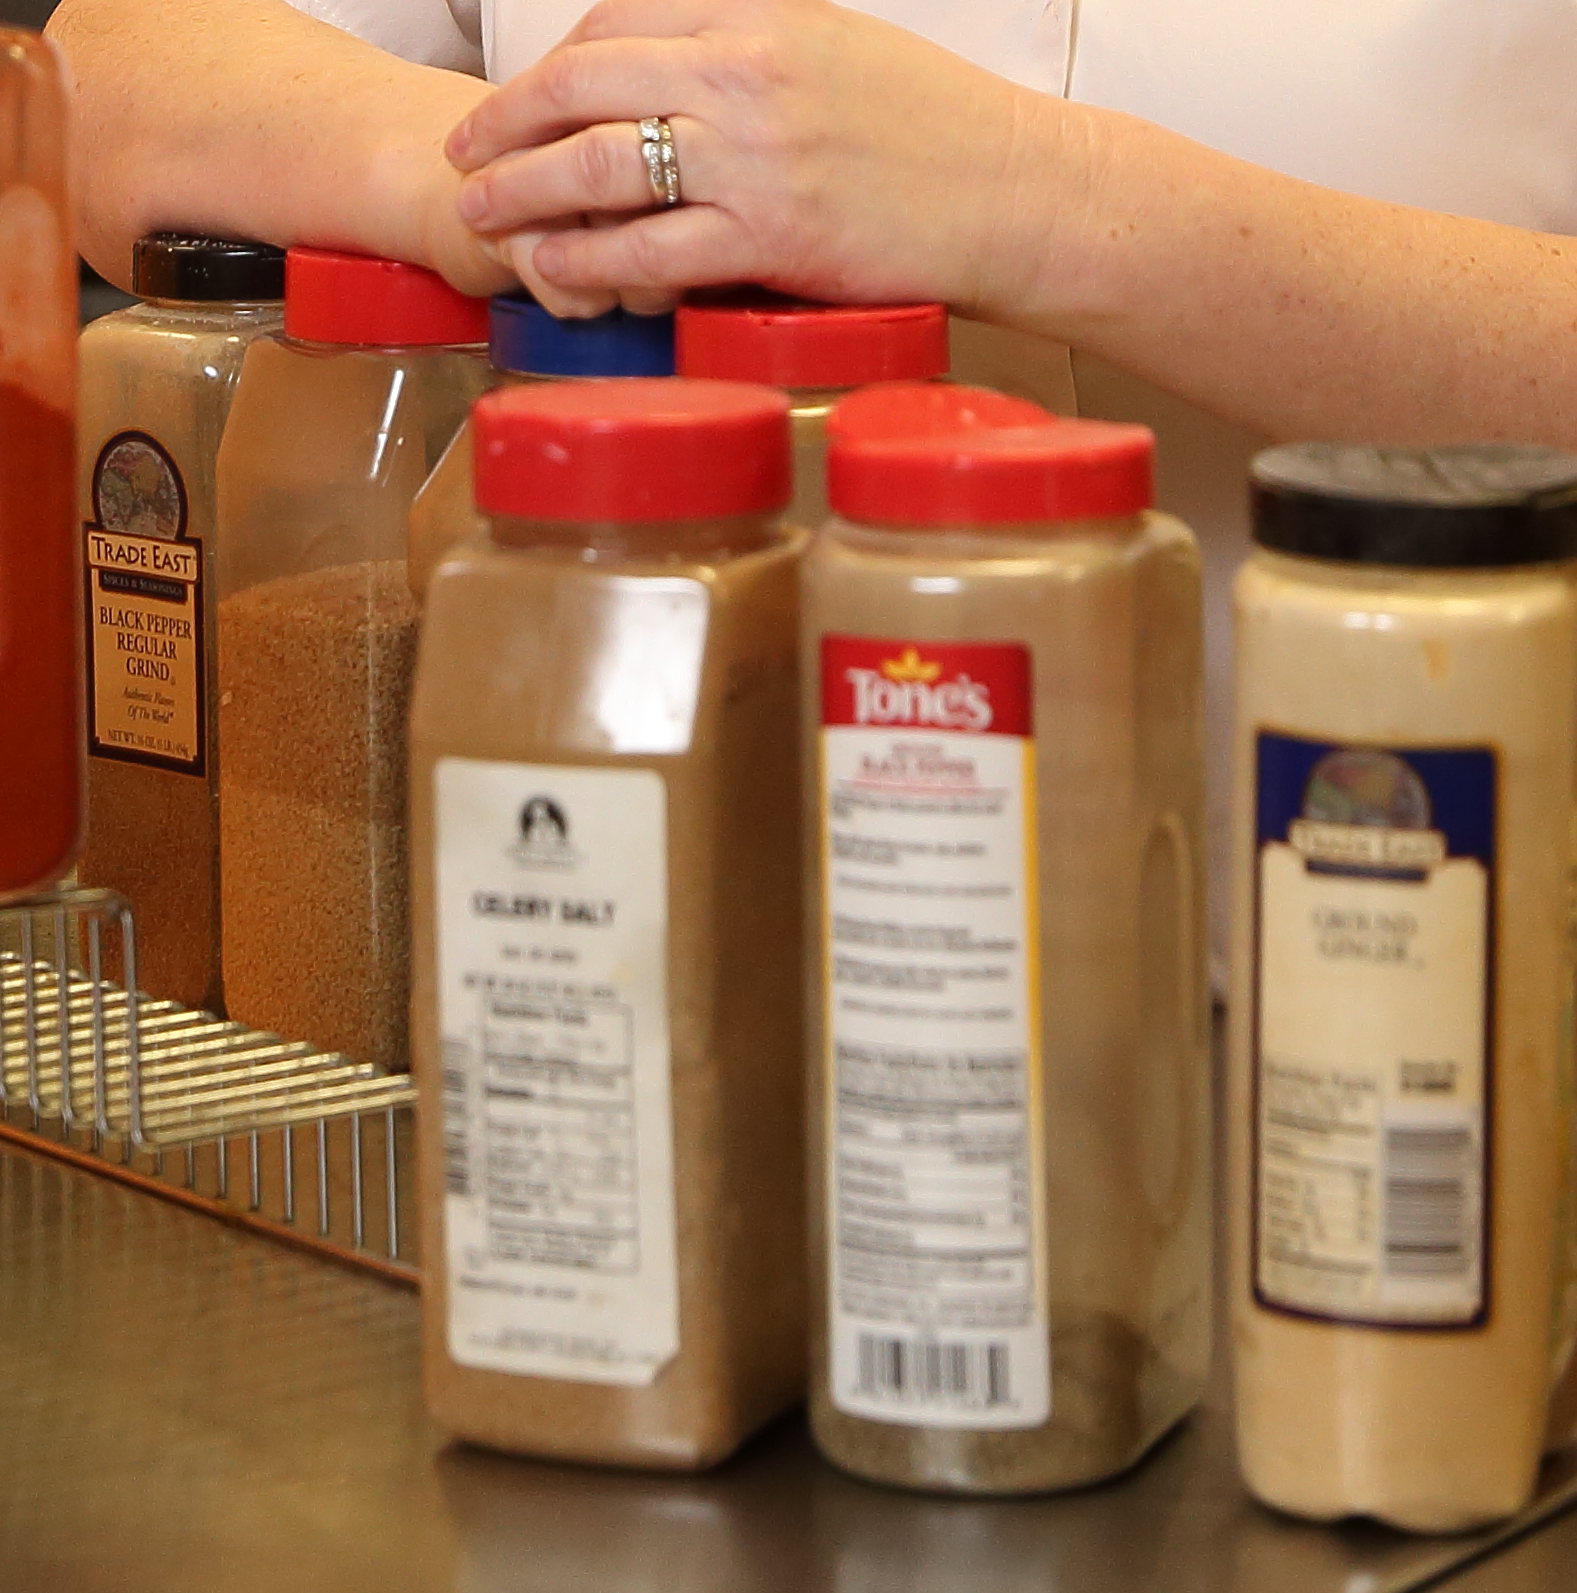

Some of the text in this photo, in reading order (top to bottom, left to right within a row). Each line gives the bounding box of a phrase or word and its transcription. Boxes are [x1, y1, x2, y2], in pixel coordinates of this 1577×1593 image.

[91, 535, 192, 575] TRADE EAST
[99, 606, 192, 639] BLACK PEPPER
[116, 631, 178, 660] REGULAR
[126, 656, 170, 681] GRIND
[846, 668, 993, 732] Tone's
[472, 892, 616, 928] CELERY SALT
